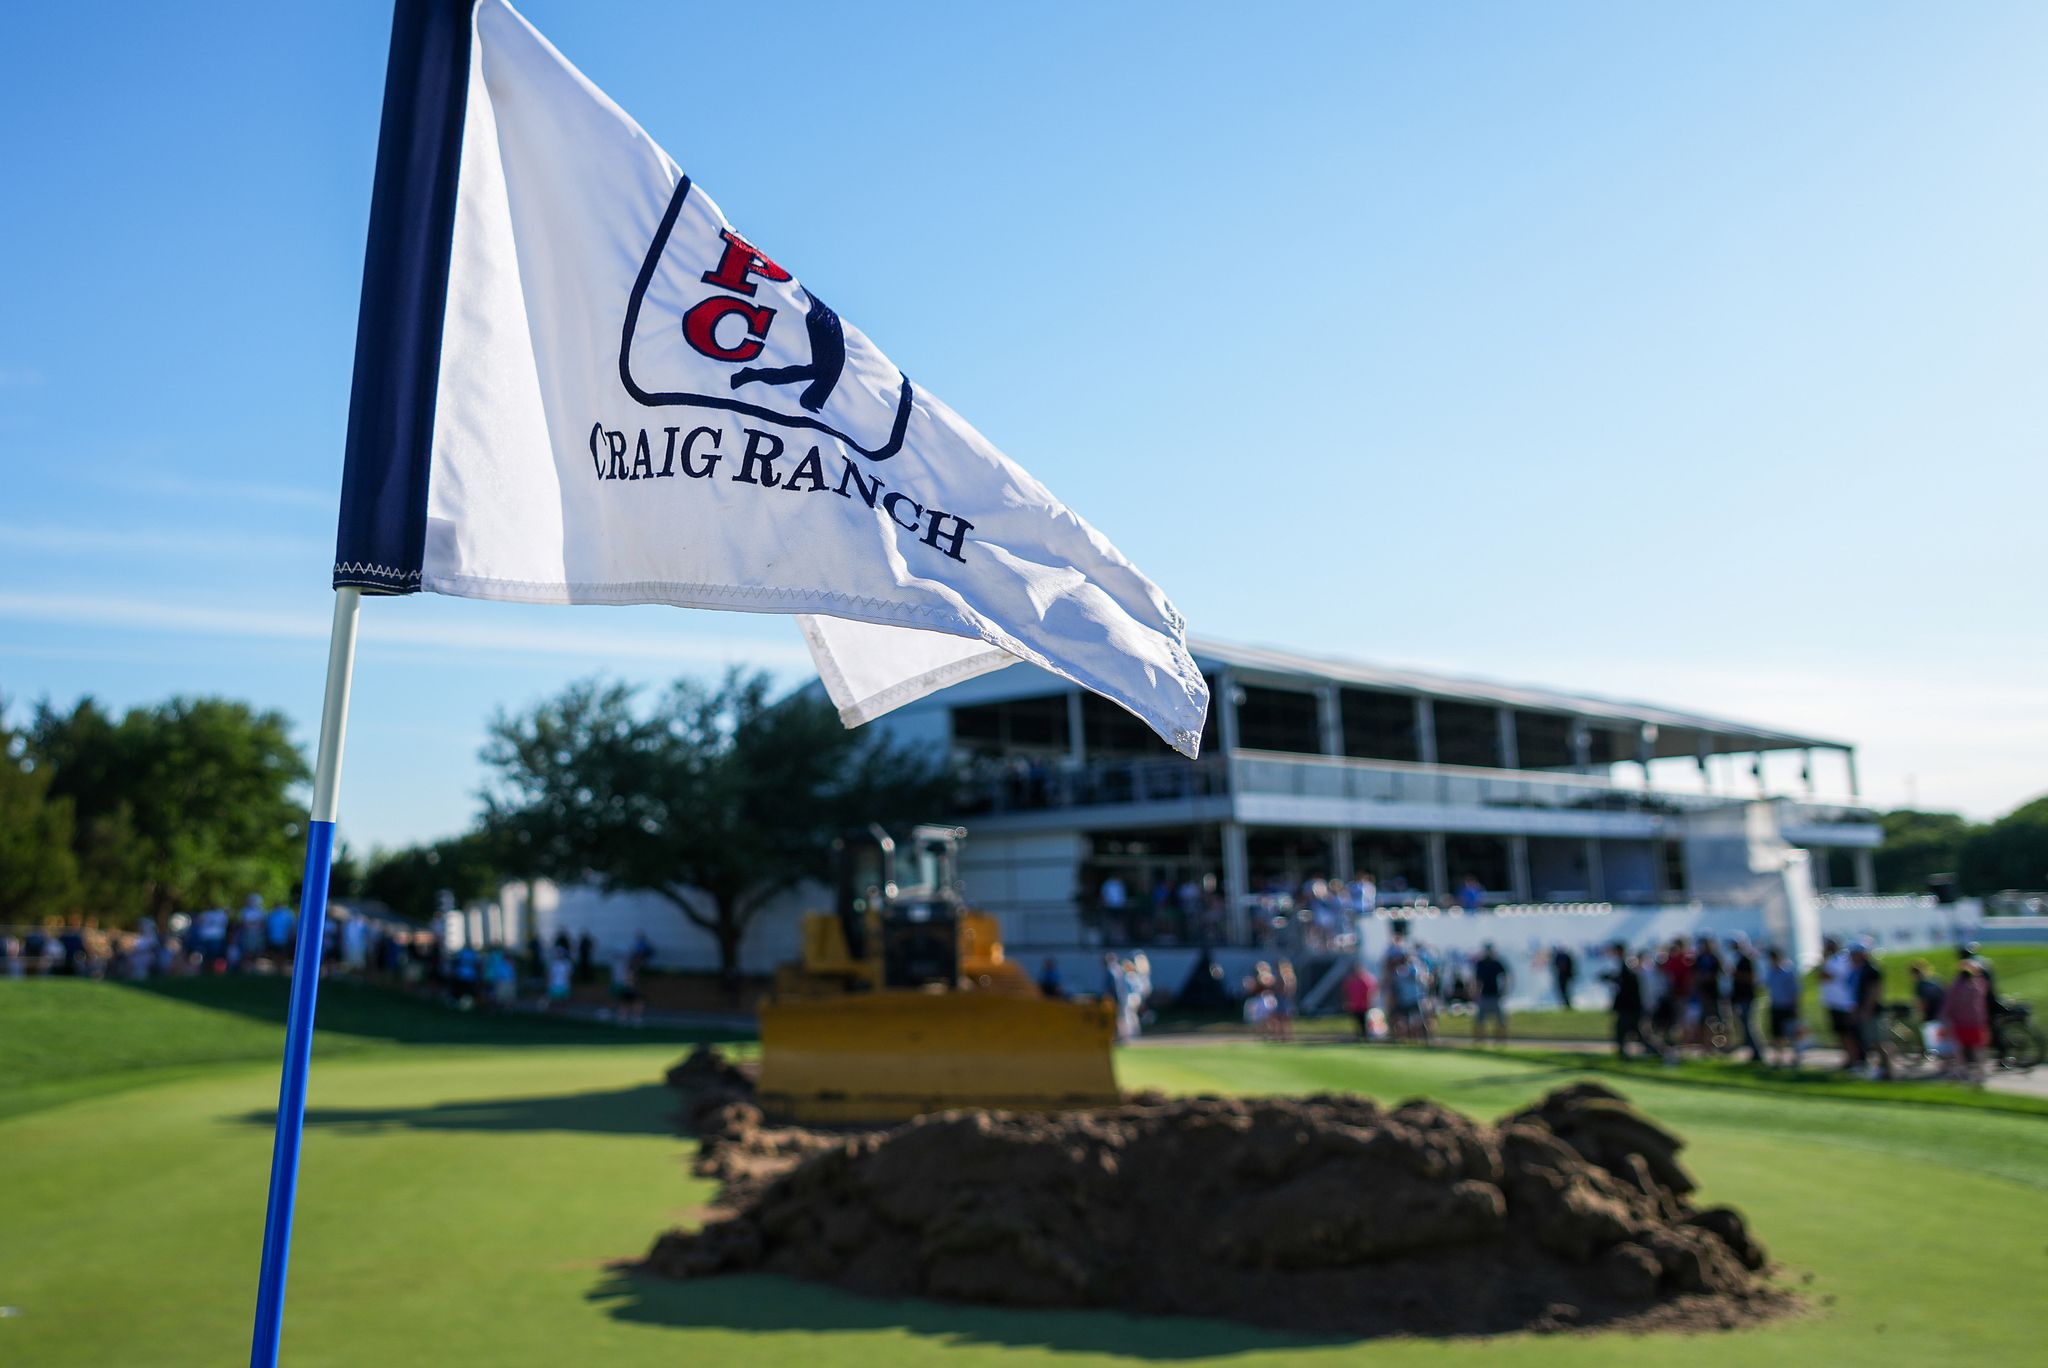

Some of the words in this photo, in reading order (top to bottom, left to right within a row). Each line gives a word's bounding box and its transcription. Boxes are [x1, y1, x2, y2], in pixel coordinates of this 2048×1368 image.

[701, 228, 793, 297] P
[682, 295, 777, 362] C
[589, 422, 722, 481] CRAIG
[732, 428, 974, 563] RANCH
